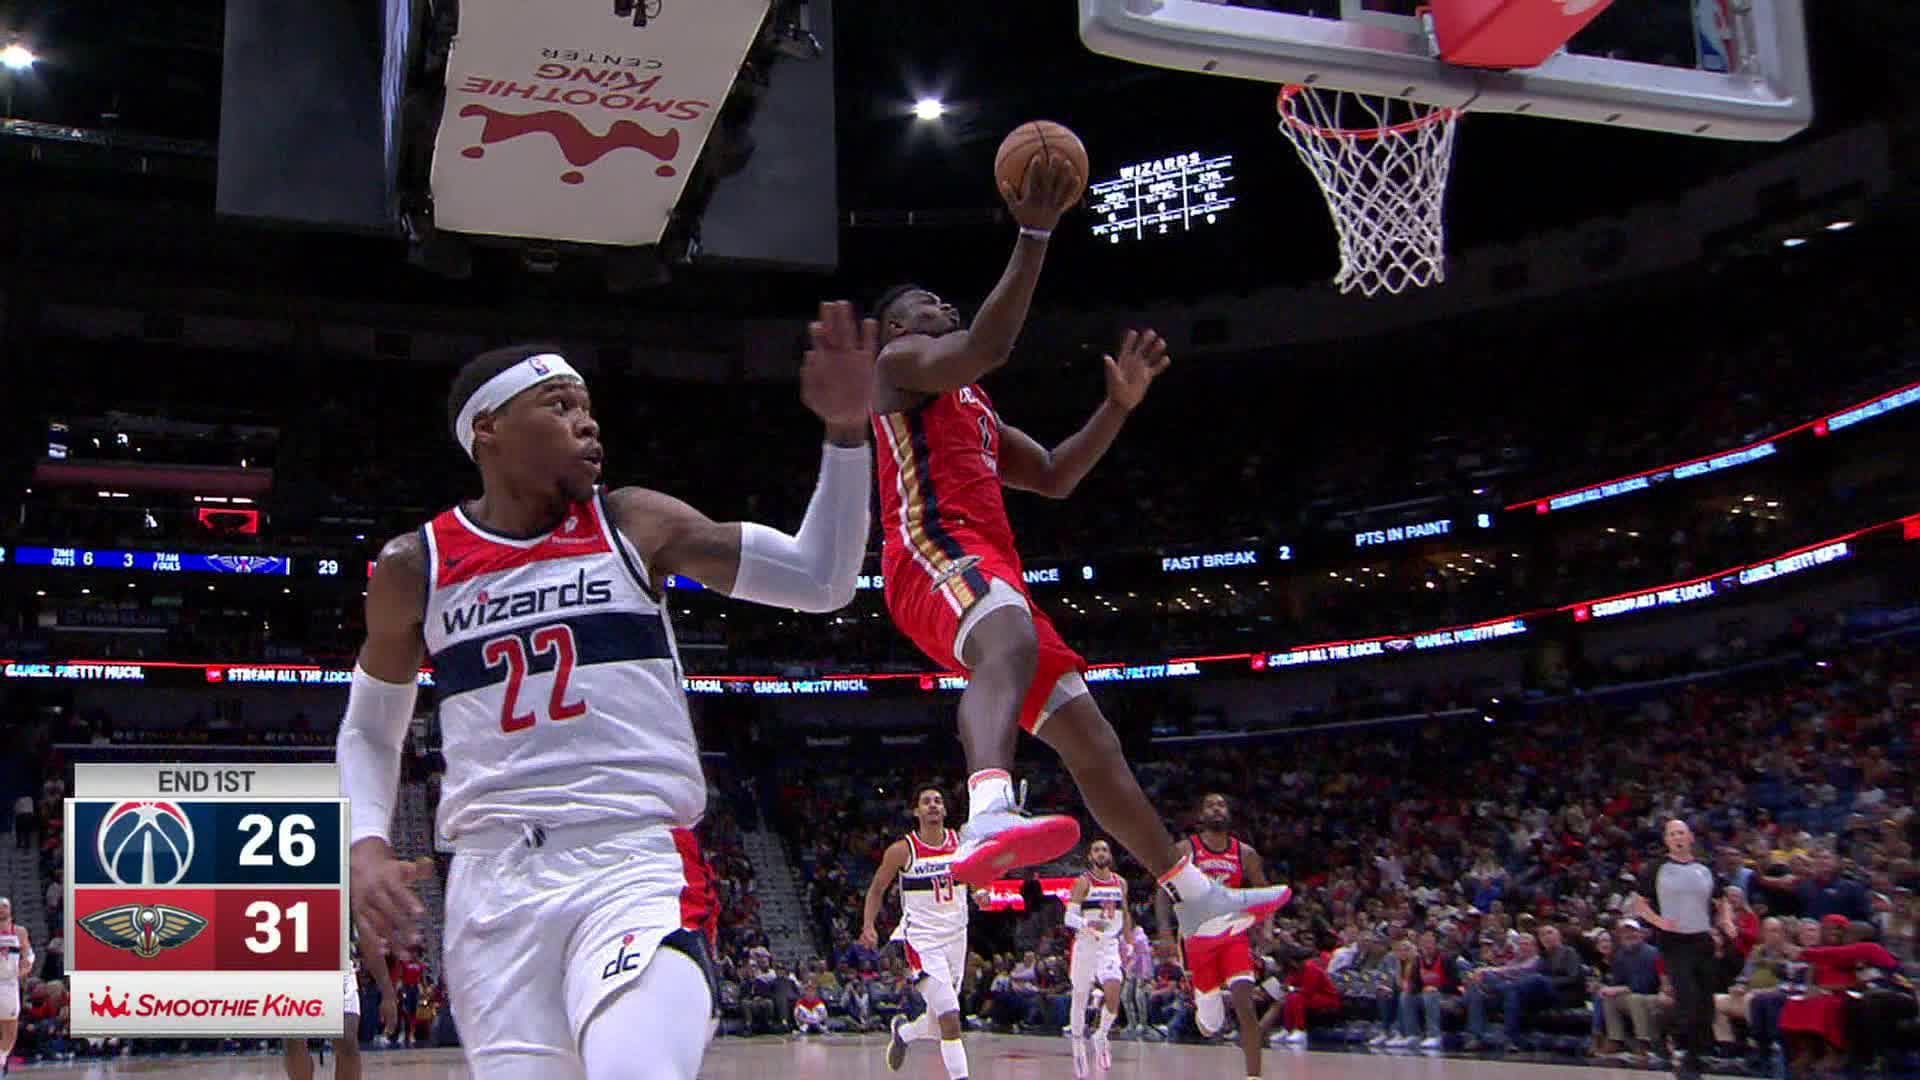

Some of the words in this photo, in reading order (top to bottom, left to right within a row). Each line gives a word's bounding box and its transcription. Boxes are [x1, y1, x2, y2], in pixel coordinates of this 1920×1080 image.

[542, 48, 663, 69] CENTER
[456, 76, 709, 120] SMOOTHIE
[1120, 152, 1200, 180] WIZARDS
[1355, 531, 1386, 547] PTS
[1387, 527, 1403, 542] IN
[1405, 519, 1451, 539] PAINT
[83, 551, 93, 566] 6
[123, 553, 134, 567] 3
[1162, 556, 1200, 571] FAST
[1203, 551, 1256, 568] BREAK
[1279, 545, 1290, 560] 2
[318, 560, 339, 575] 29
[443, 568, 613, 635] wizards
[323, 671, 353, 683] LOCA
[482, 624, 588, 736] 22
